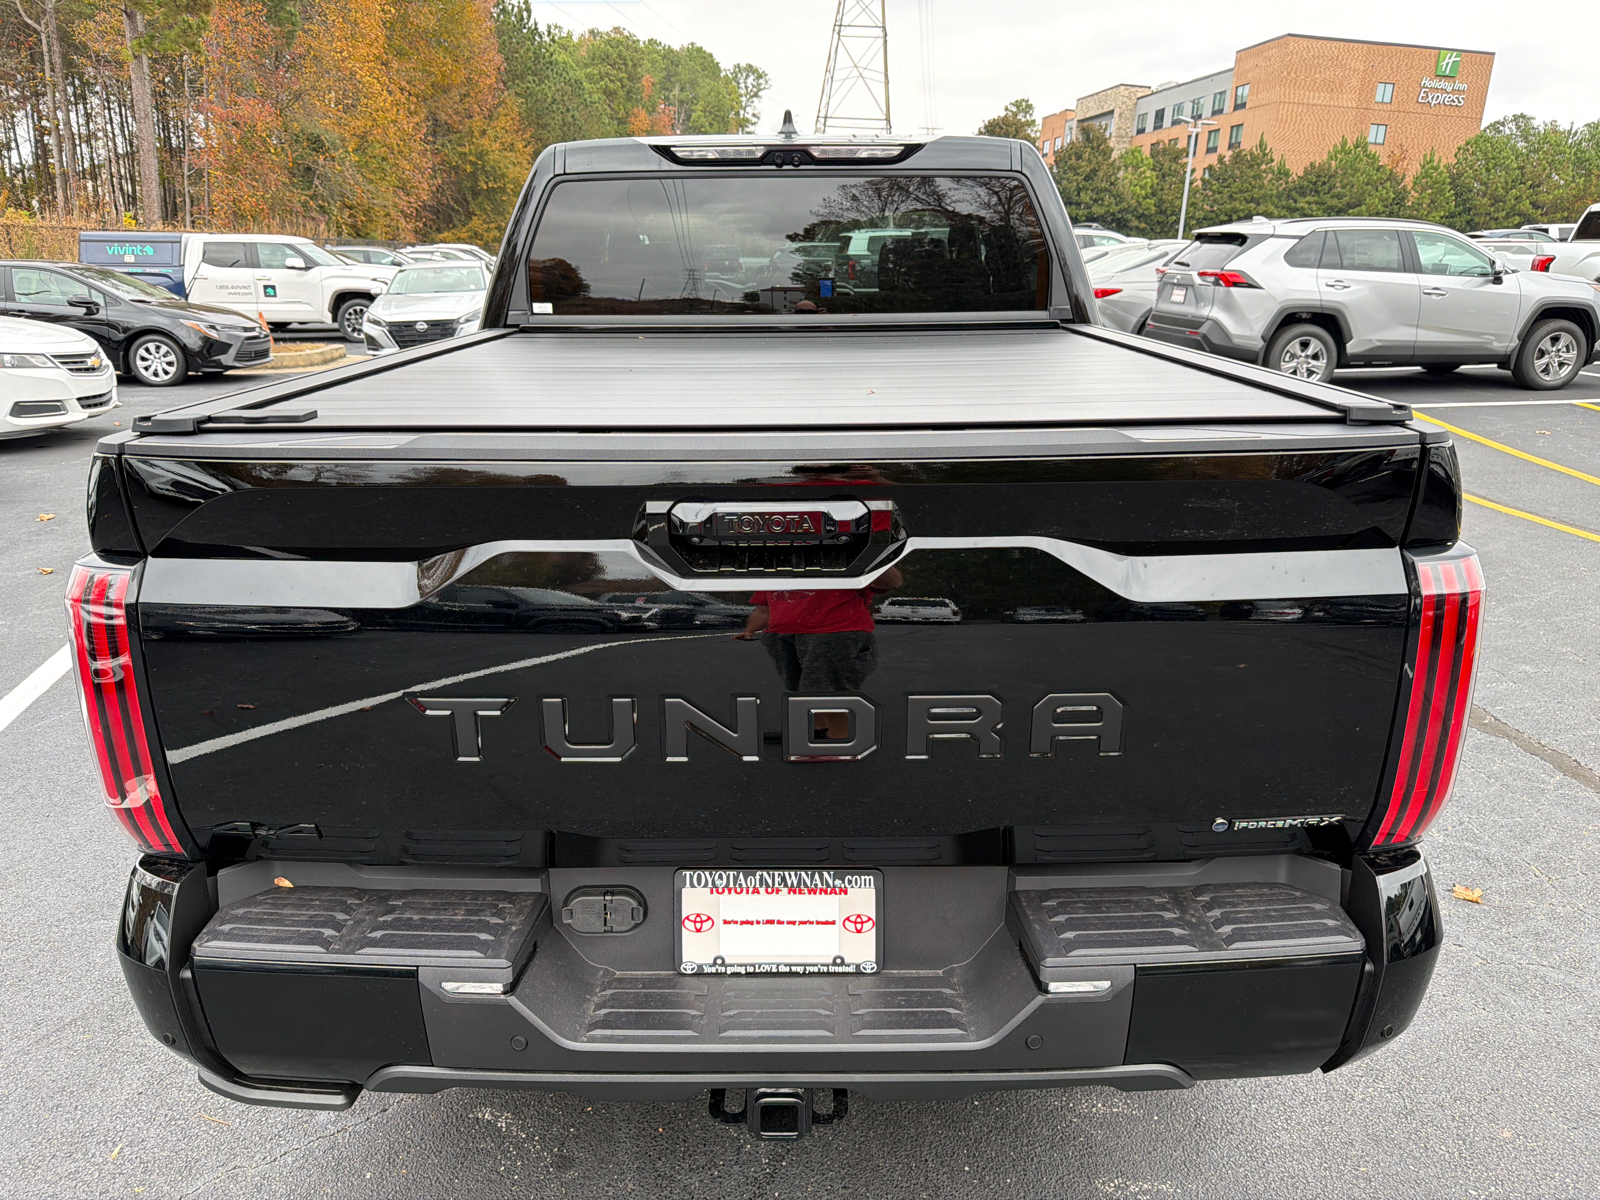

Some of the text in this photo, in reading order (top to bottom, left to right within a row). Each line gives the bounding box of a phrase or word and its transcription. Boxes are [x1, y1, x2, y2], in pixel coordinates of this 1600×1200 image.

[1420, 77, 1468, 92] Holiday Inn
[1417, 88, 1466, 108] Express
[106, 243, 143, 255] vivint
[724, 514, 816, 534] TOYOTA
[405, 690, 1125, 762] TUNDRA
[709, 887, 848, 896] TOYOTA OF NEWNAN
[702, 964, 726, 973] You're
[726, 965, 746, 974] going
[755, 964, 777, 972] LOVE
[791, 966, 804, 974] way
[805, 965, 828, 974] you're
[828, 964, 856, 972] treated!
